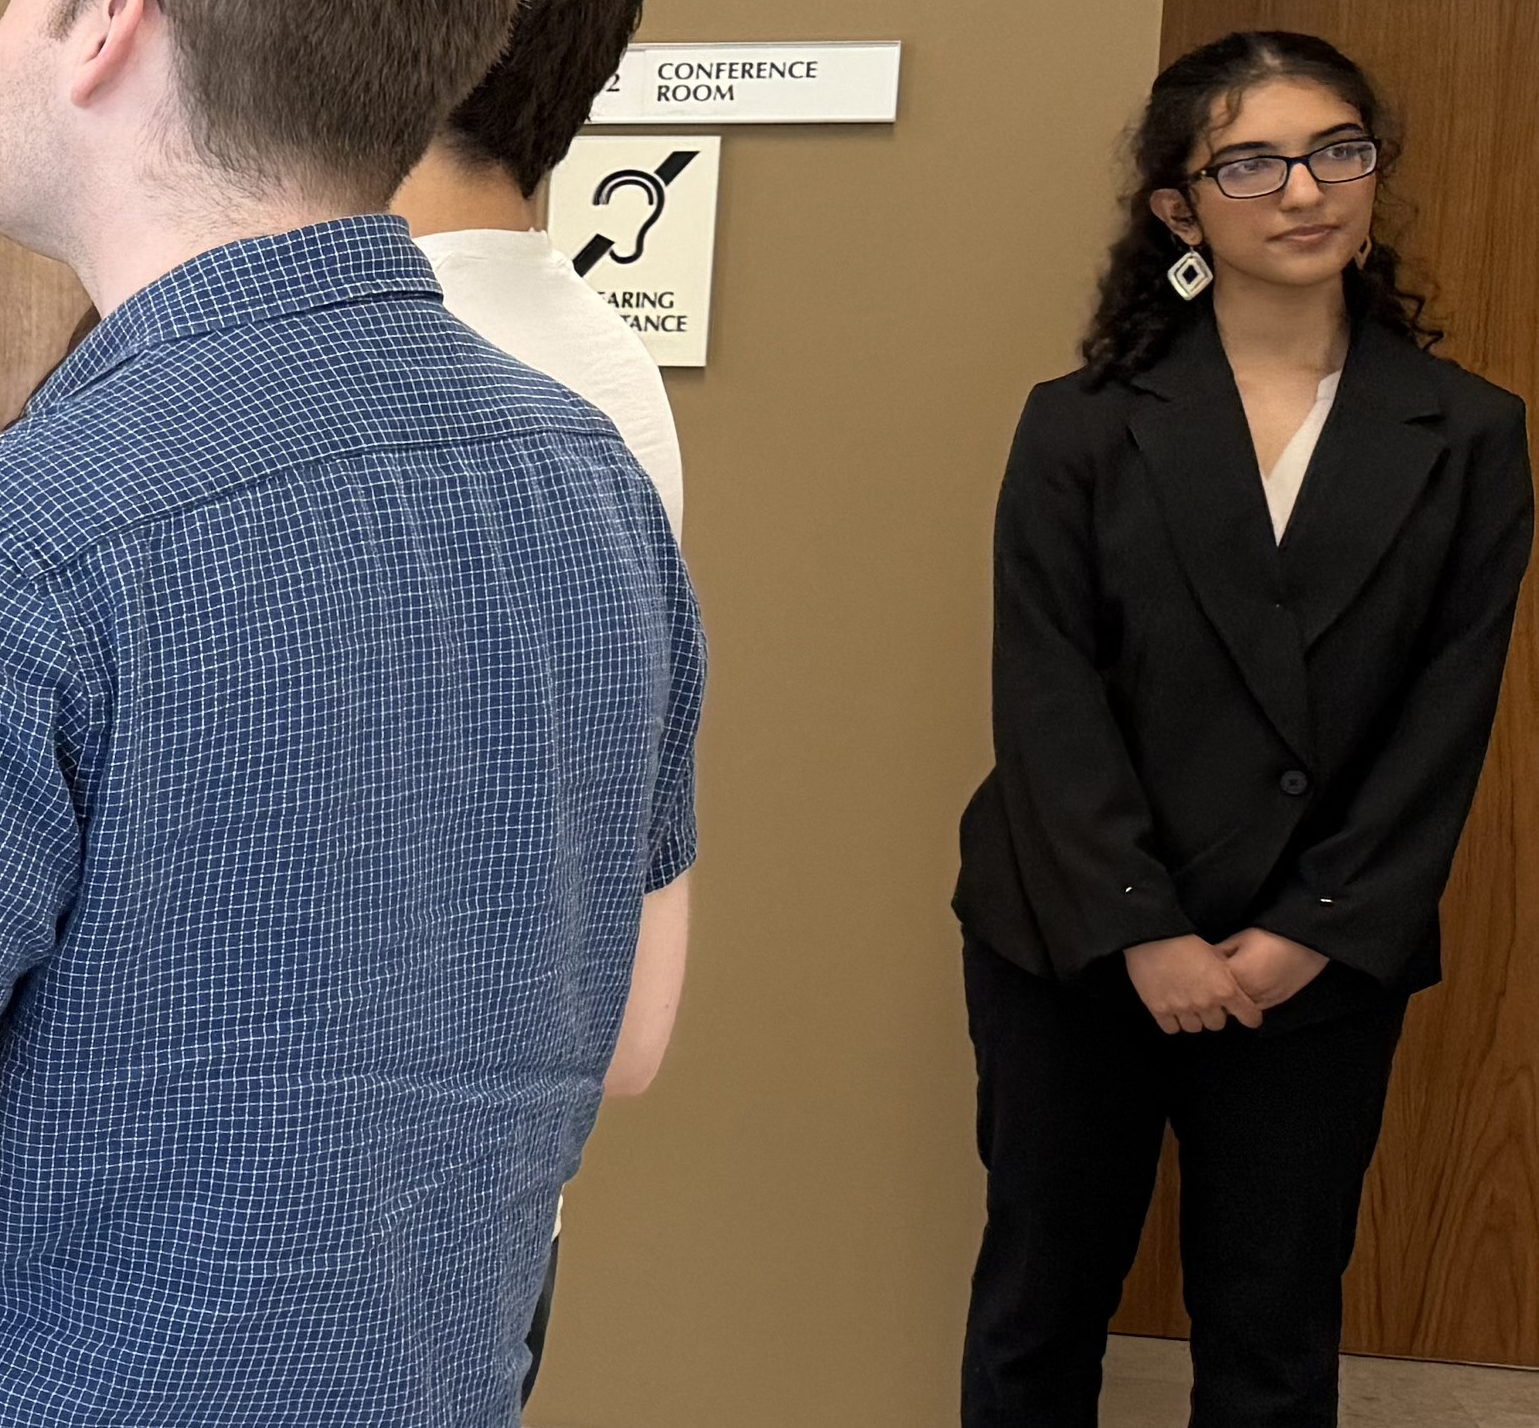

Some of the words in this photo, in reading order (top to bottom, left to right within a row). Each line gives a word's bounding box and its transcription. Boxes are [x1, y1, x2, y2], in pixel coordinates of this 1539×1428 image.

[658, 61, 818, 80] CONFERENCE
[657, 84, 735, 102] ROOM
[597, 291, 674, 309] ARING
